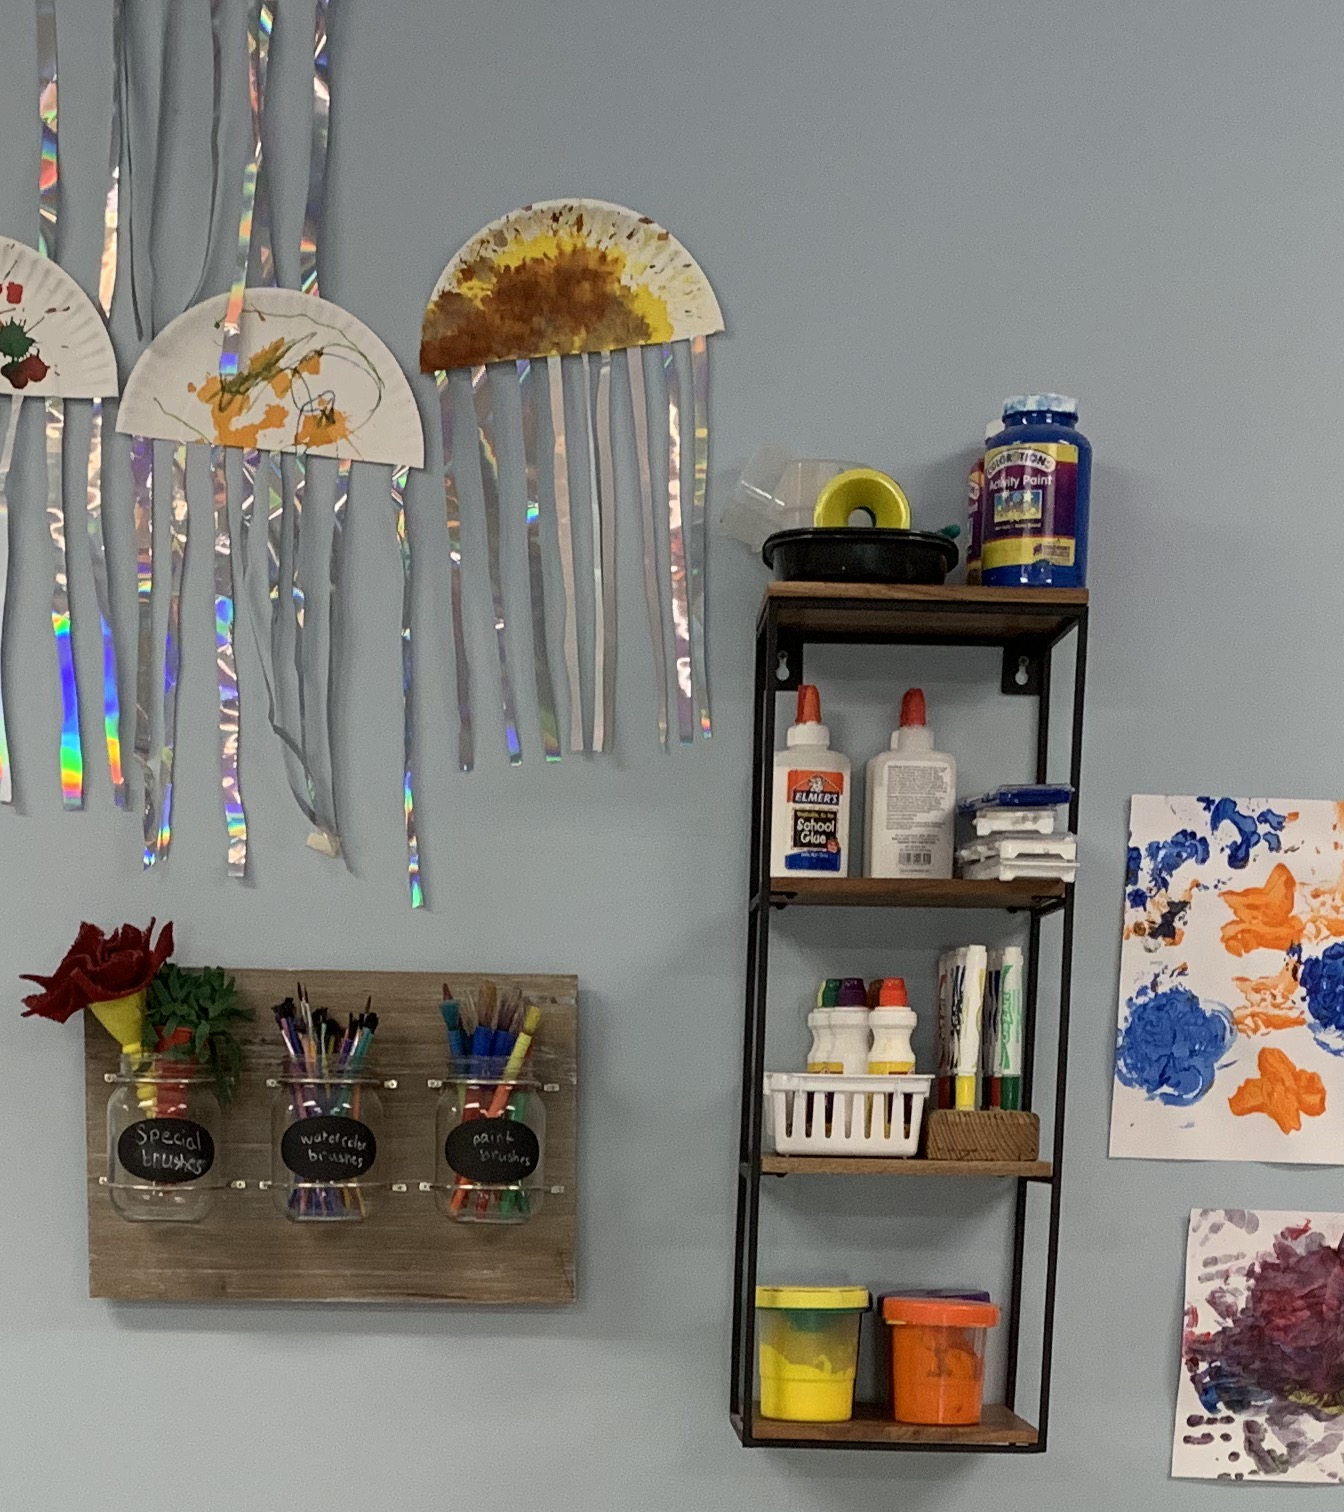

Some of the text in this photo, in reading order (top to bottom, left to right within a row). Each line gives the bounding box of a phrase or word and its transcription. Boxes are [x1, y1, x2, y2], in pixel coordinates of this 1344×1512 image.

[989, 474, 1053, 491] Activity Paint
[795, 791, 838, 804] ELMER'S
[796, 818, 835, 832] School
[800, 831, 827, 844] Glue
[136, 1123, 202, 1151] Special
[473, 1130, 515, 1146] paint
[141, 1149, 203, 1175] brushes
[308, 1149, 363, 1169] brushes
[479, 1149, 531, 1167] brushes
